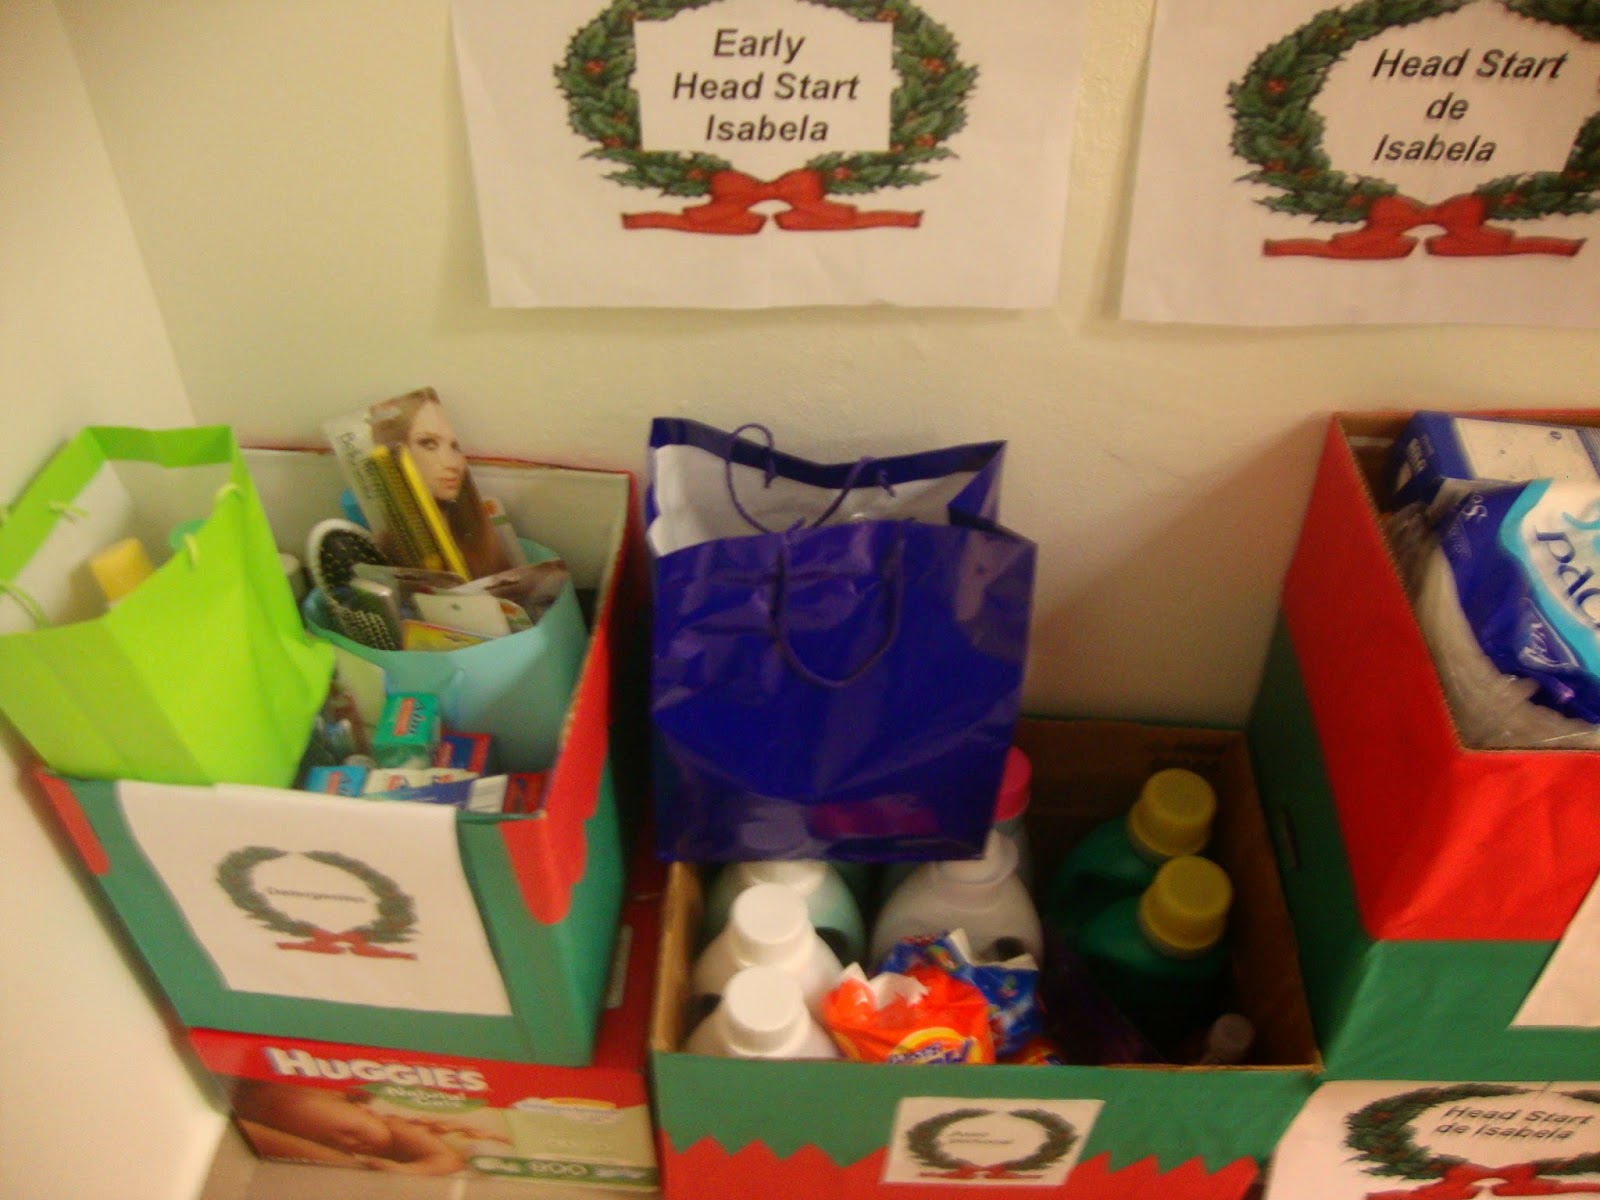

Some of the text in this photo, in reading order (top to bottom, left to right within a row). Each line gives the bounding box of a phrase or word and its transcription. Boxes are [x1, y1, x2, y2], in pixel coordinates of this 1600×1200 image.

[713, 28, 806, 64] Early
[1372, 48, 1569, 79] Head Start
[673, 72, 860, 100] Head Start
[1426, 92, 1469, 120] de
[706, 114, 829, 141] Isabela
[1373, 134, 1497, 162] Isabela
[1443, 1105, 1595, 1124] Head Start
[1434, 1122, 1575, 1140] de Isabela
